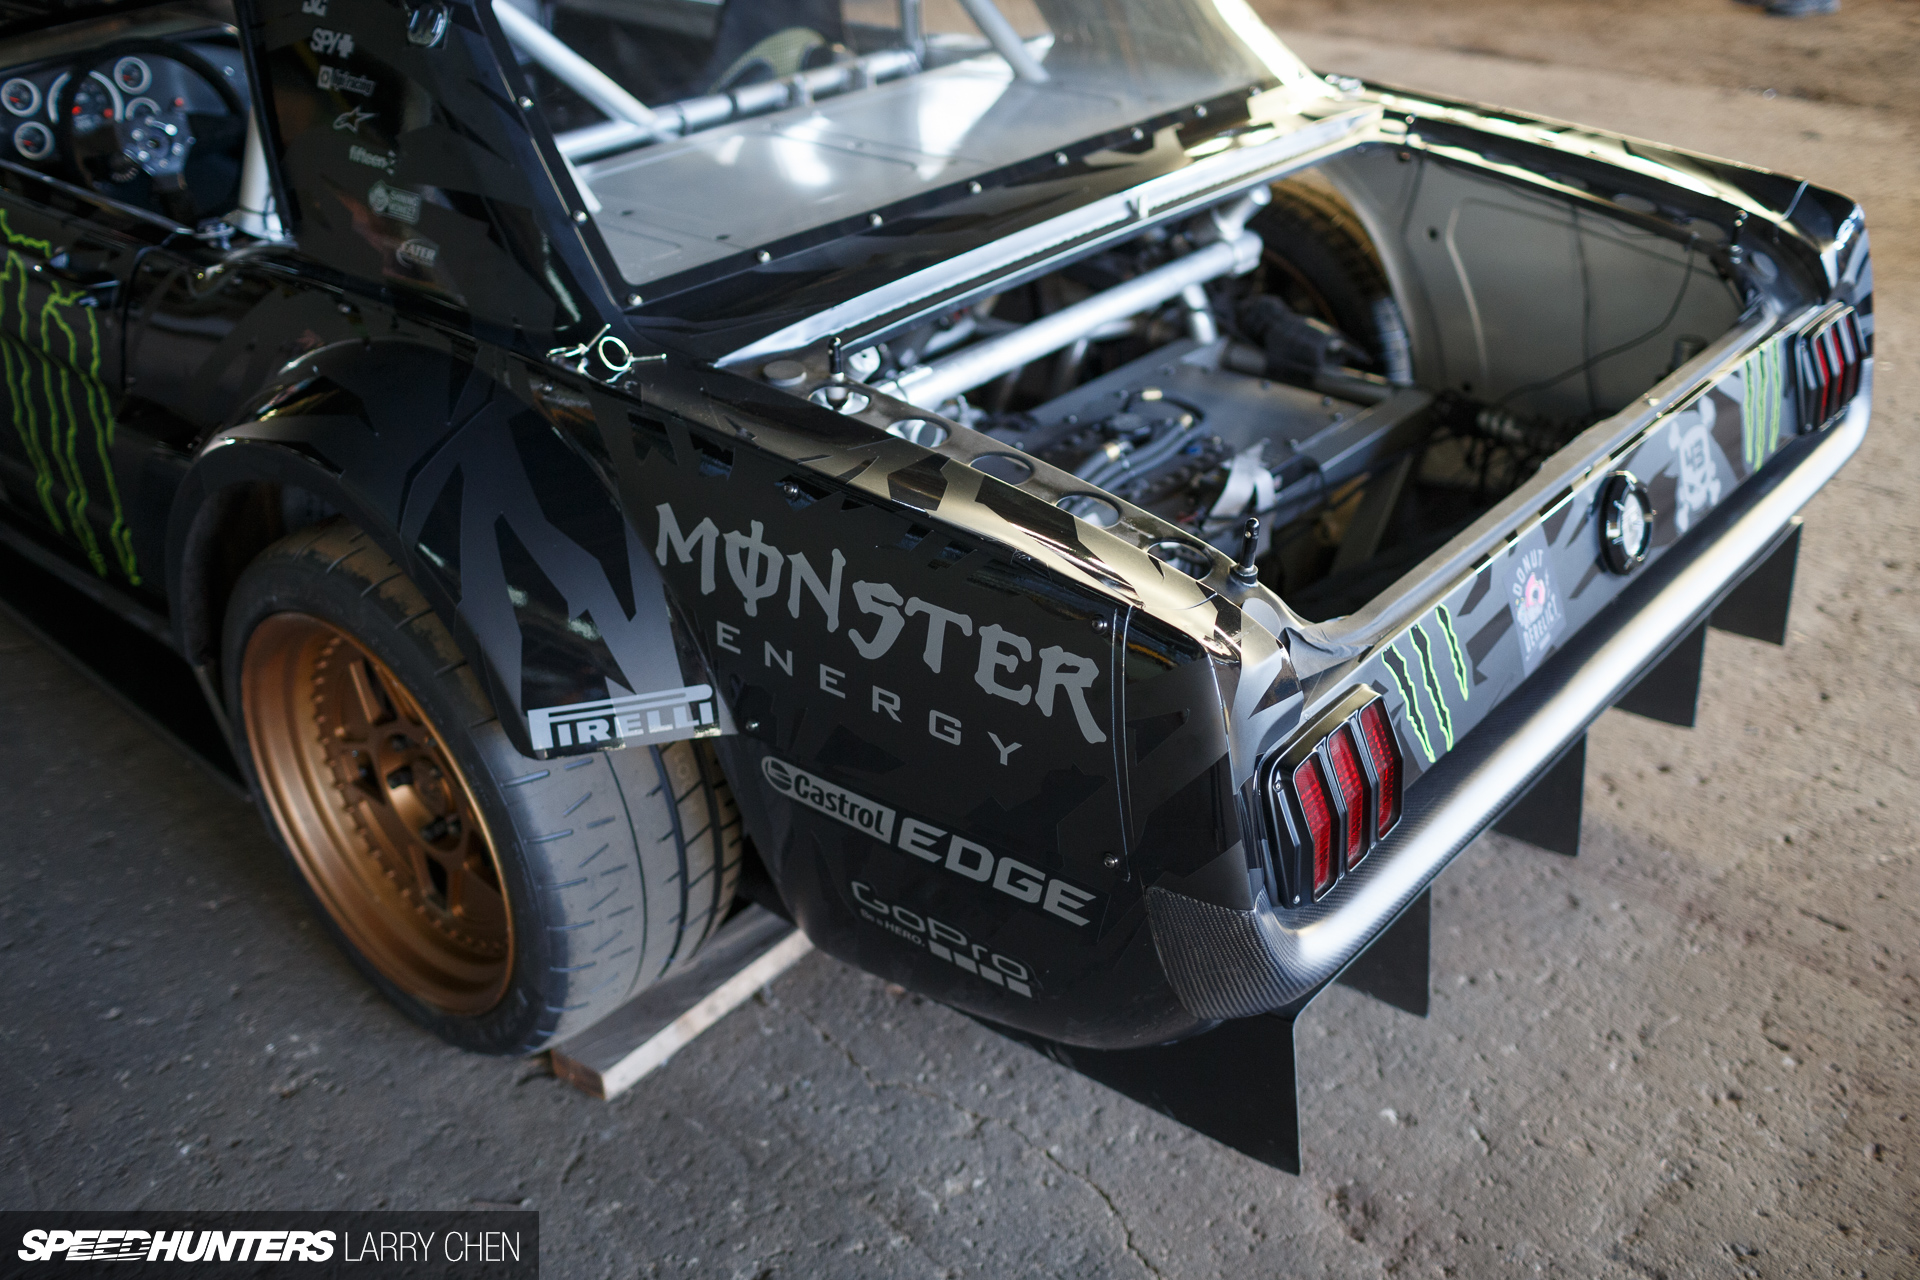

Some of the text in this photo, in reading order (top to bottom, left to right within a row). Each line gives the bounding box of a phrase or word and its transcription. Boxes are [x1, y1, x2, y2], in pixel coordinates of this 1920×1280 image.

[1512, 548, 1545, 598] DONUT
[1522, 593, 1559, 653] DERELICT
[527, 684, 713, 751] PIRELLI
[716, 620, 1023, 766] ENERGY
[792, 771, 886, 837] Castrol
[898, 816, 1098, 927] EDGE
[850, 880, 1030, 981] GoPro
